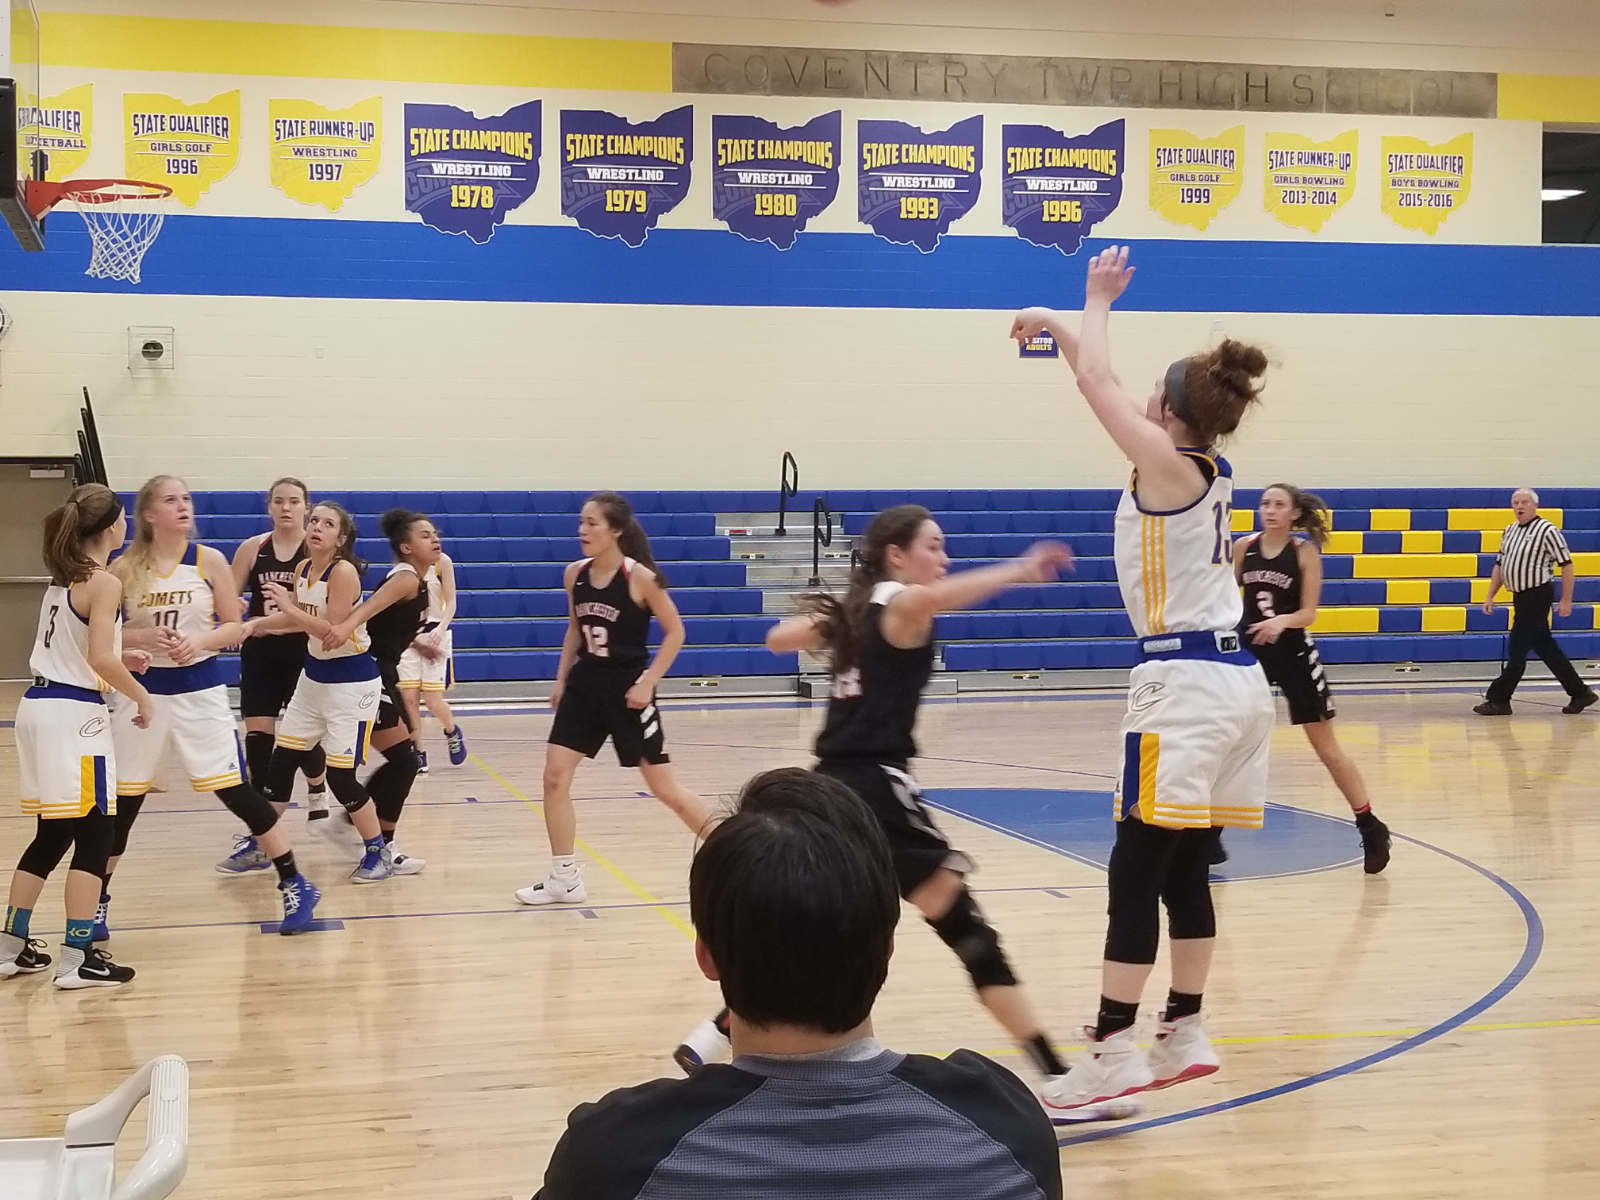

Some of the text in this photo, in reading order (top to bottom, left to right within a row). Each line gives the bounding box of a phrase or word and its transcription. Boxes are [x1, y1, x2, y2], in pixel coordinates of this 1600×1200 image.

[703, 53, 1009, 97] COVENTRY
[1158, 68, 1270, 104] HIGH
[133, 114, 229, 139] STATE QUALIFIER
[275, 119, 374, 142] STATE RUNNER-UP
[150, 142, 212, 153] GIRLS GOLF
[292, 147, 358, 157] WRESTLING
[410, 128, 532, 160] STATE CHAMPIONS
[566, 133, 684, 165] STATE CHAMPIONS
[717, 139, 833, 169] STATE CHAMPIONS
[166, 158, 198, 174] 1996
[863, 143, 975, 173] STATE CHAMPIONS
[1007, 147, 1117, 176] STATE CHAMPIONS
[1156, 147, 1235, 170] STATE QUALIFIER
[1268, 150, 1351, 172] STATE RUNNER-UP
[1388, 154, 1463, 175] STATE QUALIFIER
[308, 163, 342, 181] 1997
[431, 163, 511, 176] WRESTLING
[587, 168, 664, 181] WRESTLING
[738, 172, 813, 185] WRESTLING
[1170, 173, 1221, 183] GIRLS GOLF
[1274, 175, 1345, 186] GIRLS BOWLING
[882, 176, 956, 189] WRESTLING
[1026, 179, 1097, 191] WRESTLING
[1391, 179, 1459, 188] BOYS BOWLING
[450, 185, 494, 208] 1978
[605, 189, 647, 212] 1979
[754, 193, 796, 216] 1980
[1180, 187, 1210, 204] 1999
[1281, 190, 1337, 205] 2013-2014
[1398, 193, 1453, 207] 2015-2016
[900, 197, 938, 219] 1993
[1042, 200, 1081, 222] 1996
[1256, 591, 1276, 617] 2
[44, 605, 59, 648] 3
[582, 625, 609, 657] 12
